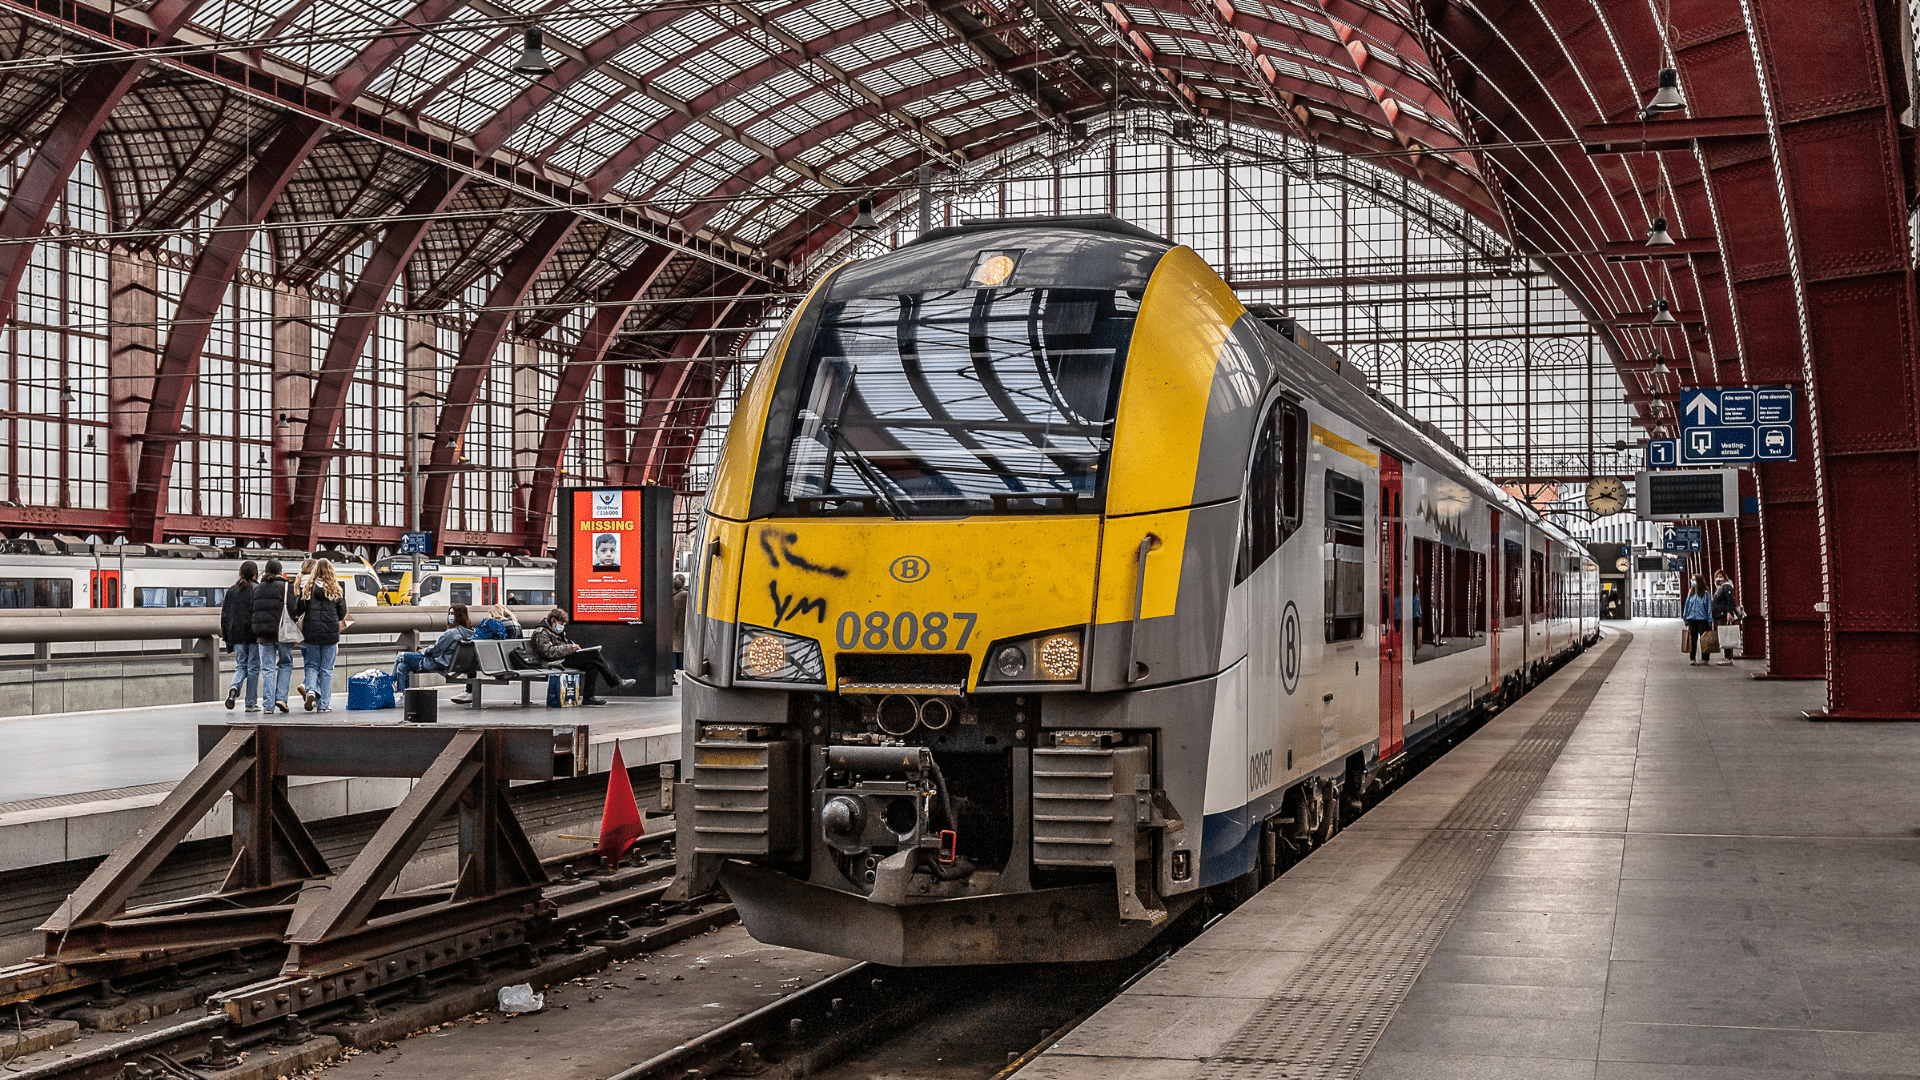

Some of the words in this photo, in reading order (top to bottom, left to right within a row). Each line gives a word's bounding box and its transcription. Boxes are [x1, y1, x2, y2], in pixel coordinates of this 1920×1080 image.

[1658, 447, 1665, 461] 1
[580, 520, 634, 531] MISSING
[82, 583, 88, 593] 2
[835, 611, 978, 651] 08087
[1250, 748, 1272, 792] 08087
